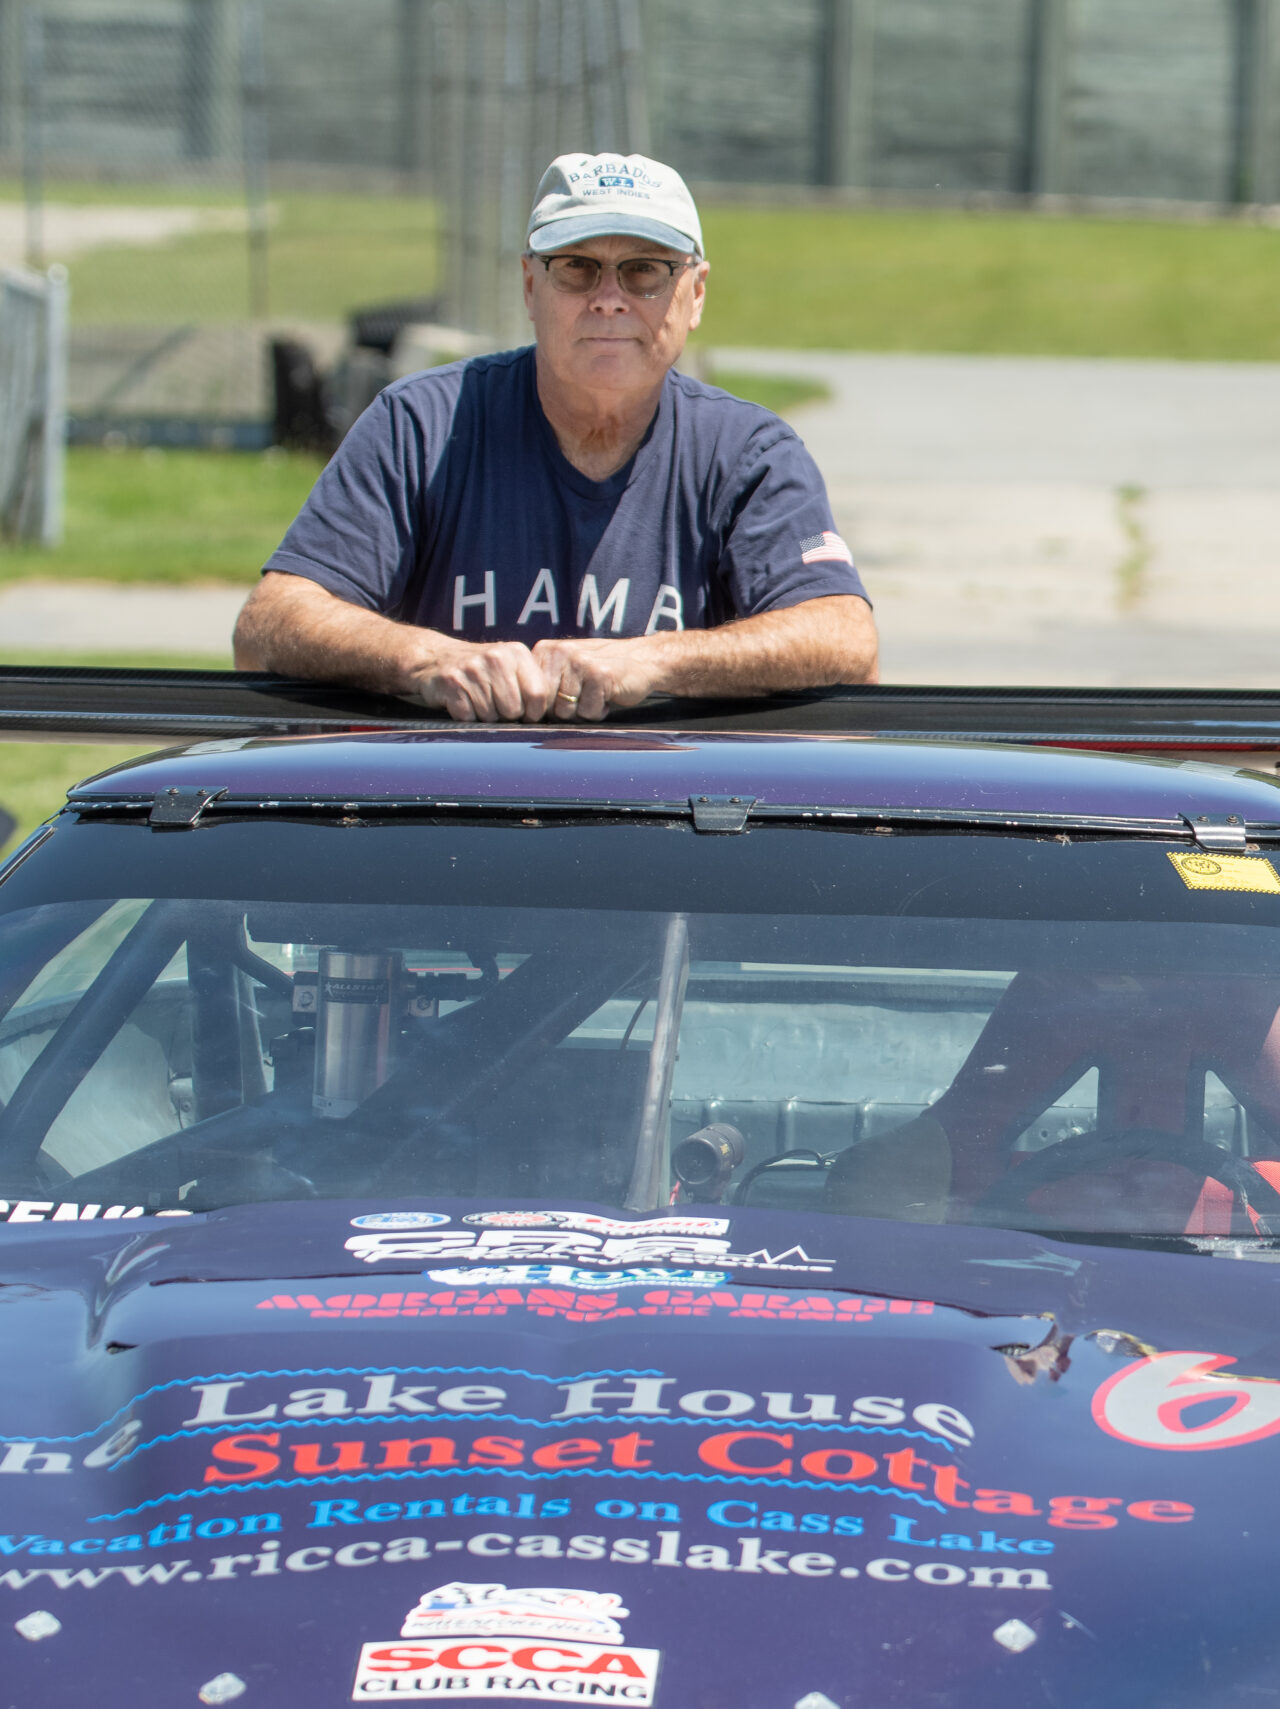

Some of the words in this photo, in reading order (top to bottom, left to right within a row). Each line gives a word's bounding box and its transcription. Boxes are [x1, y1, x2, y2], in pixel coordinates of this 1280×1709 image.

[569, 163, 662, 188] BARBADOS
[583, 189, 612, 197] WEST
[617, 188, 650, 199] INDIES
[453, 568, 703, 635] HAMB
[644, 1290, 935, 1315] GARAGE
[0, 1419, 142, 1474] he
[182, 1374, 507, 1427] Lake
[551, 1377, 975, 1447] House
[203, 1431, 655, 1483] Sunset
[698, 1430, 1196, 1530] Cottage
[0, 1511, 282, 1556] Vacation
[306, 1493, 571, 1528] Rentals
[595, 1499, 682, 1524] on
[707, 1499, 865, 1538] Cass
[888, 1514, 1056, 1556] Lake
[0, 1530, 1052, 1590] www.ricca-casslake.com
[367, 1645, 648, 1680] SCCA
[359, 1675, 470, 1693] CLUB
[486, 1675, 648, 1699] RACING
